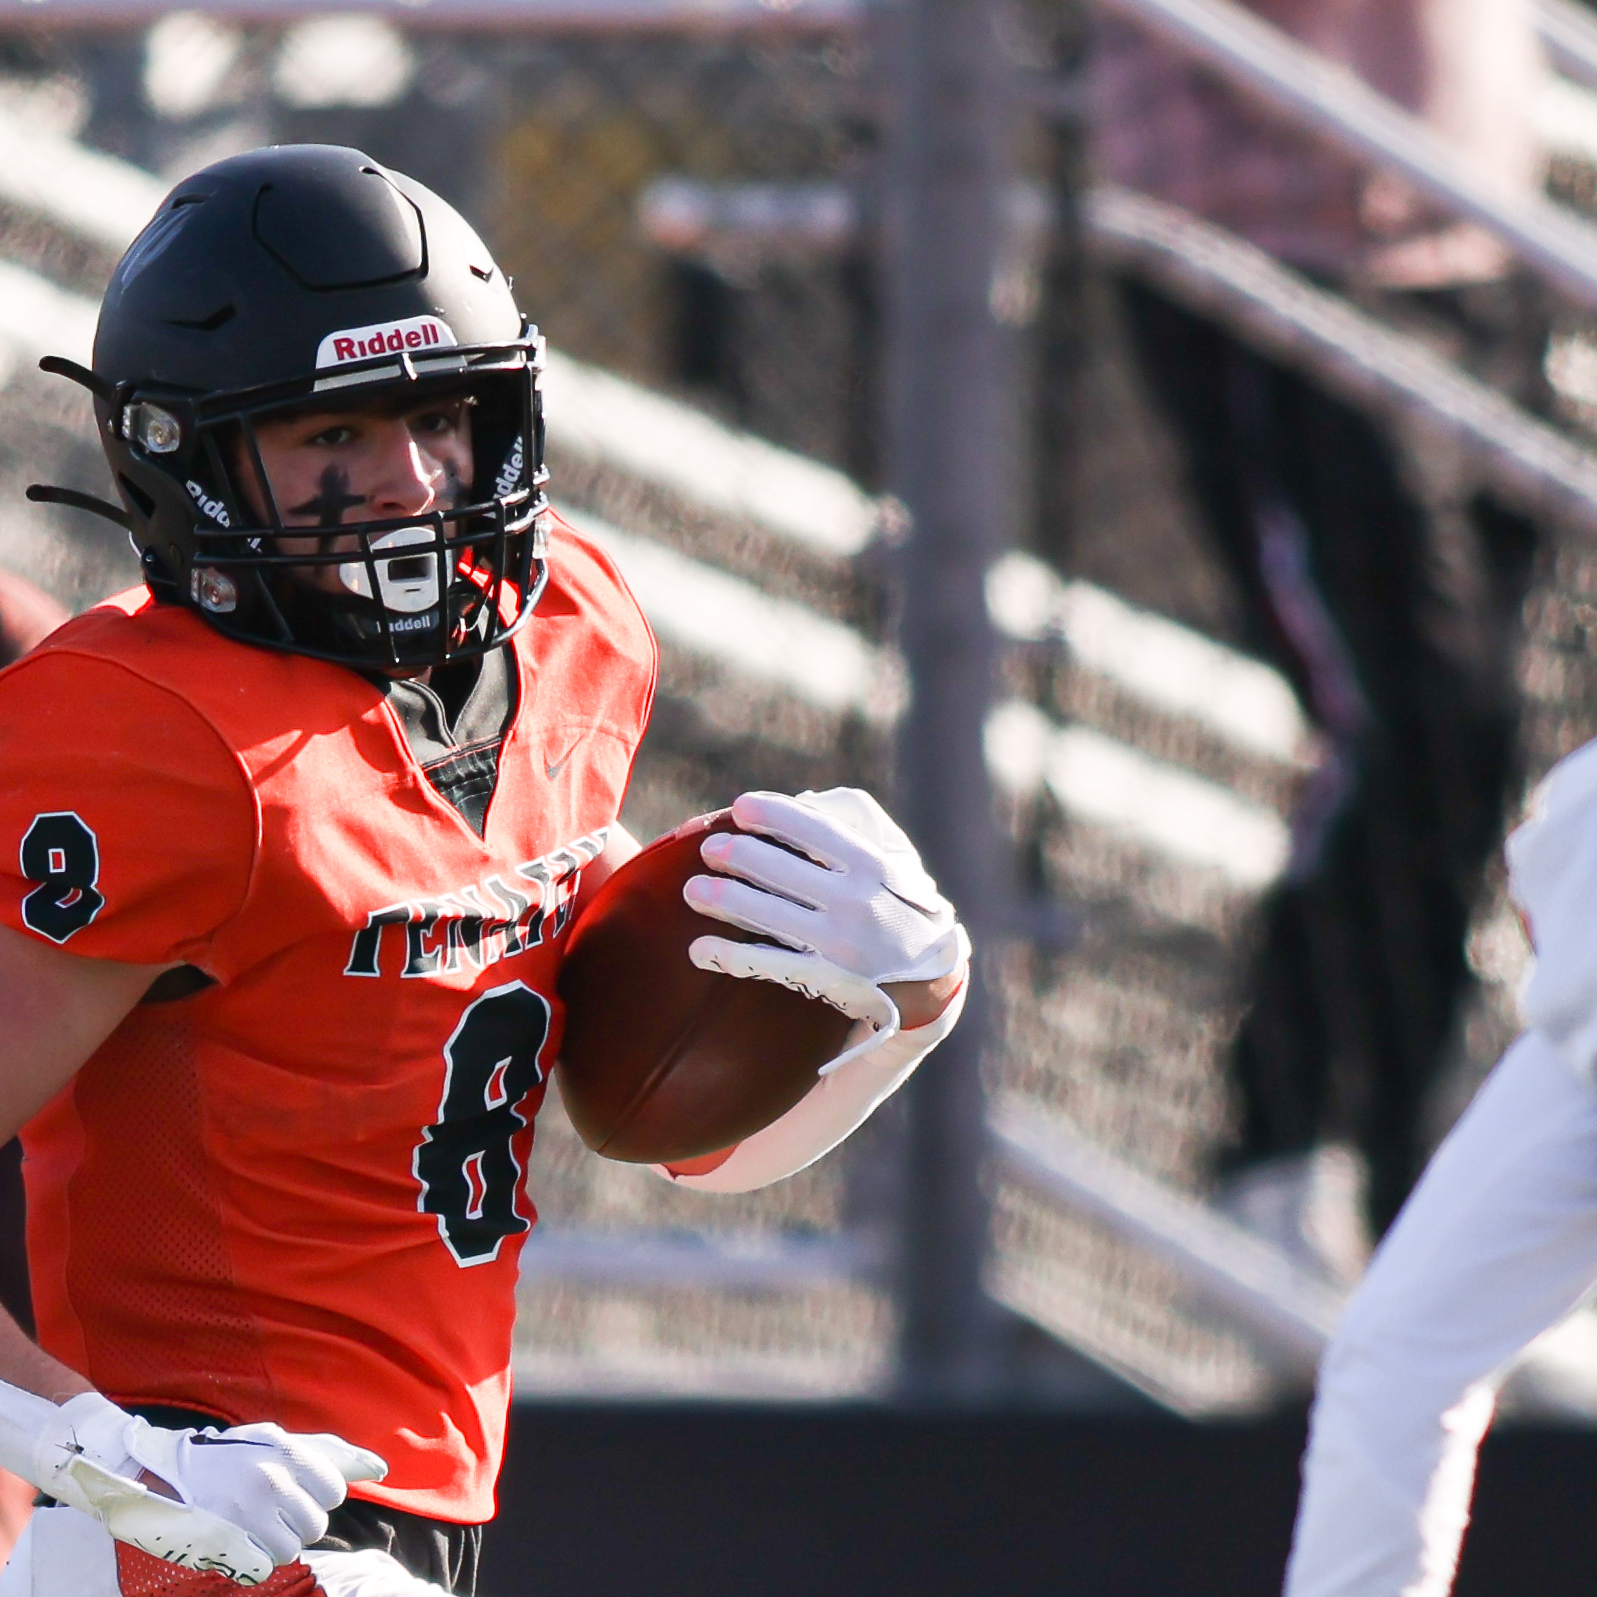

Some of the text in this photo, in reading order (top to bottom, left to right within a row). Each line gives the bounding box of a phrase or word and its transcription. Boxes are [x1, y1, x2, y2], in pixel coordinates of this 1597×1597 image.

[333, 323, 440, 361] Riddell
[376, 615, 431, 634] iddell
[19, 811, 105, 944] 8
[412, 978, 552, 1268] 8
